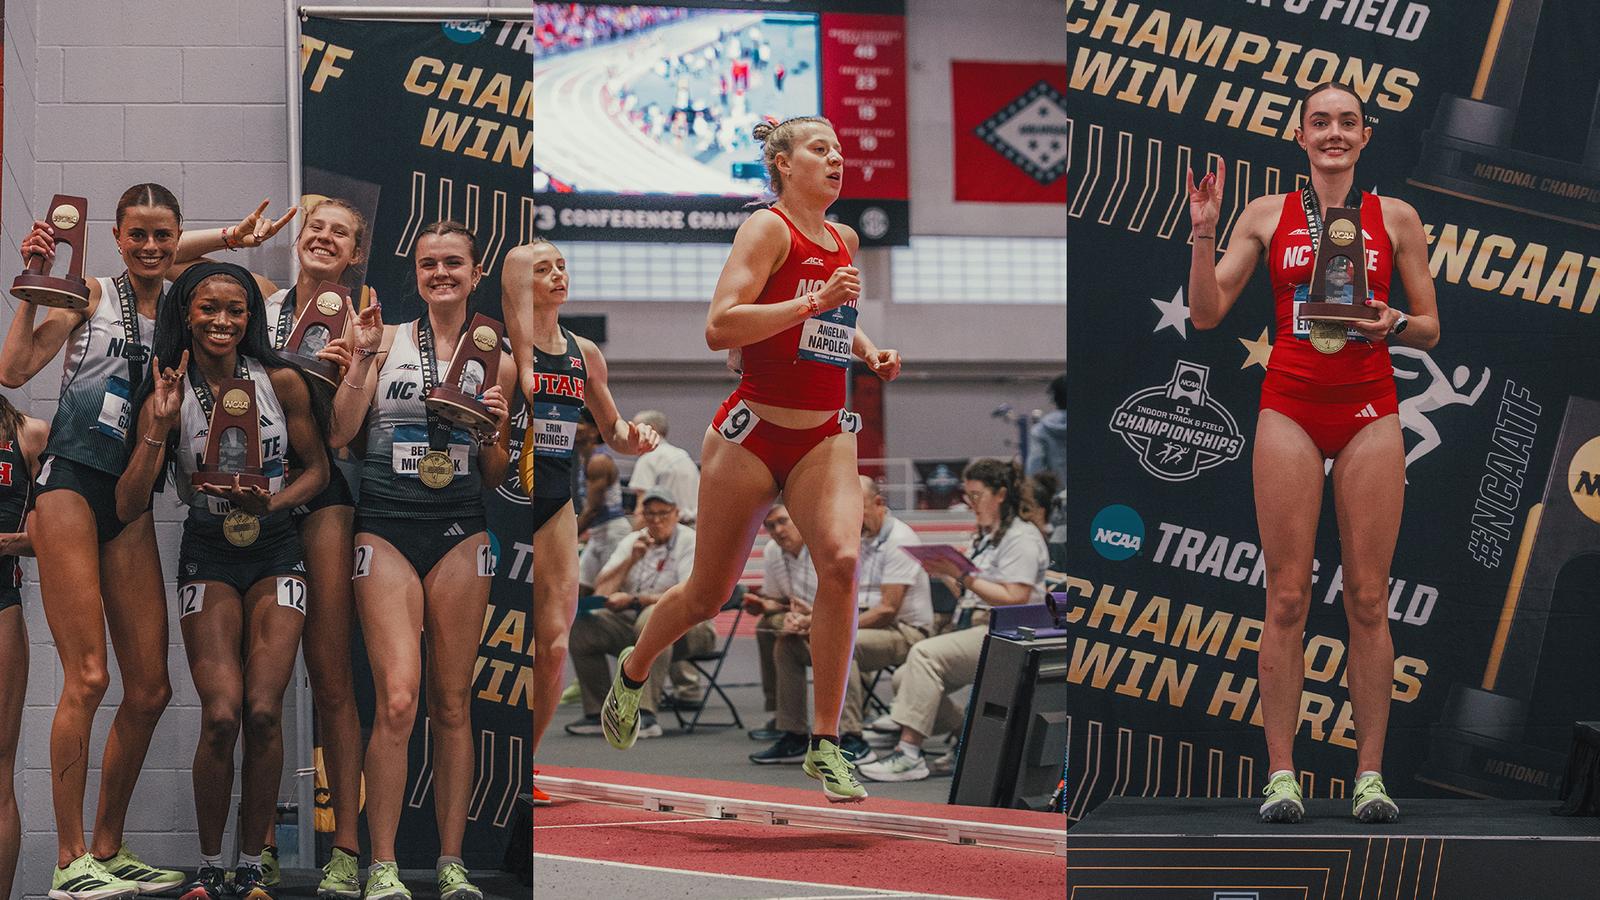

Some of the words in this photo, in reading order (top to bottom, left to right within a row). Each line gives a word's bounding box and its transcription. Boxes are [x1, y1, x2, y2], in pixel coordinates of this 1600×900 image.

[1067, 0, 1420, 112] CHAMPIONS
[1069, 47, 1197, 114] WIN
[420, 107, 533, 168] WIN
[1474, 162, 1538, 190] NATIONAL
[560, 207, 685, 229] CONFERENCE
[1331, 230, 1354, 240] NCAA
[801, 256, 825, 266] ACC
[386, 381, 417, 400] NC
[1180, 379, 1200, 389] NCAA
[225, 400, 249, 409] NCAA
[1176, 405, 1190, 415] DI
[546, 423, 561, 433] ERIN
[724, 408, 750, 439] 9
[1137, 406, 1168, 418] INDOOR
[1169, 413, 1193, 425] TRACK
[1202, 421, 1224, 433] FIELD
[534, 432, 569, 446] VRINGER
[1115, 411, 1239, 454] CHAMPIONSHIPS
[1468, 379, 1542, 569] #NCAATF
[1094, 527, 1141, 551] NCAA
[284, 579, 305, 611] 12
[1067, 637, 1198, 708] WIN
